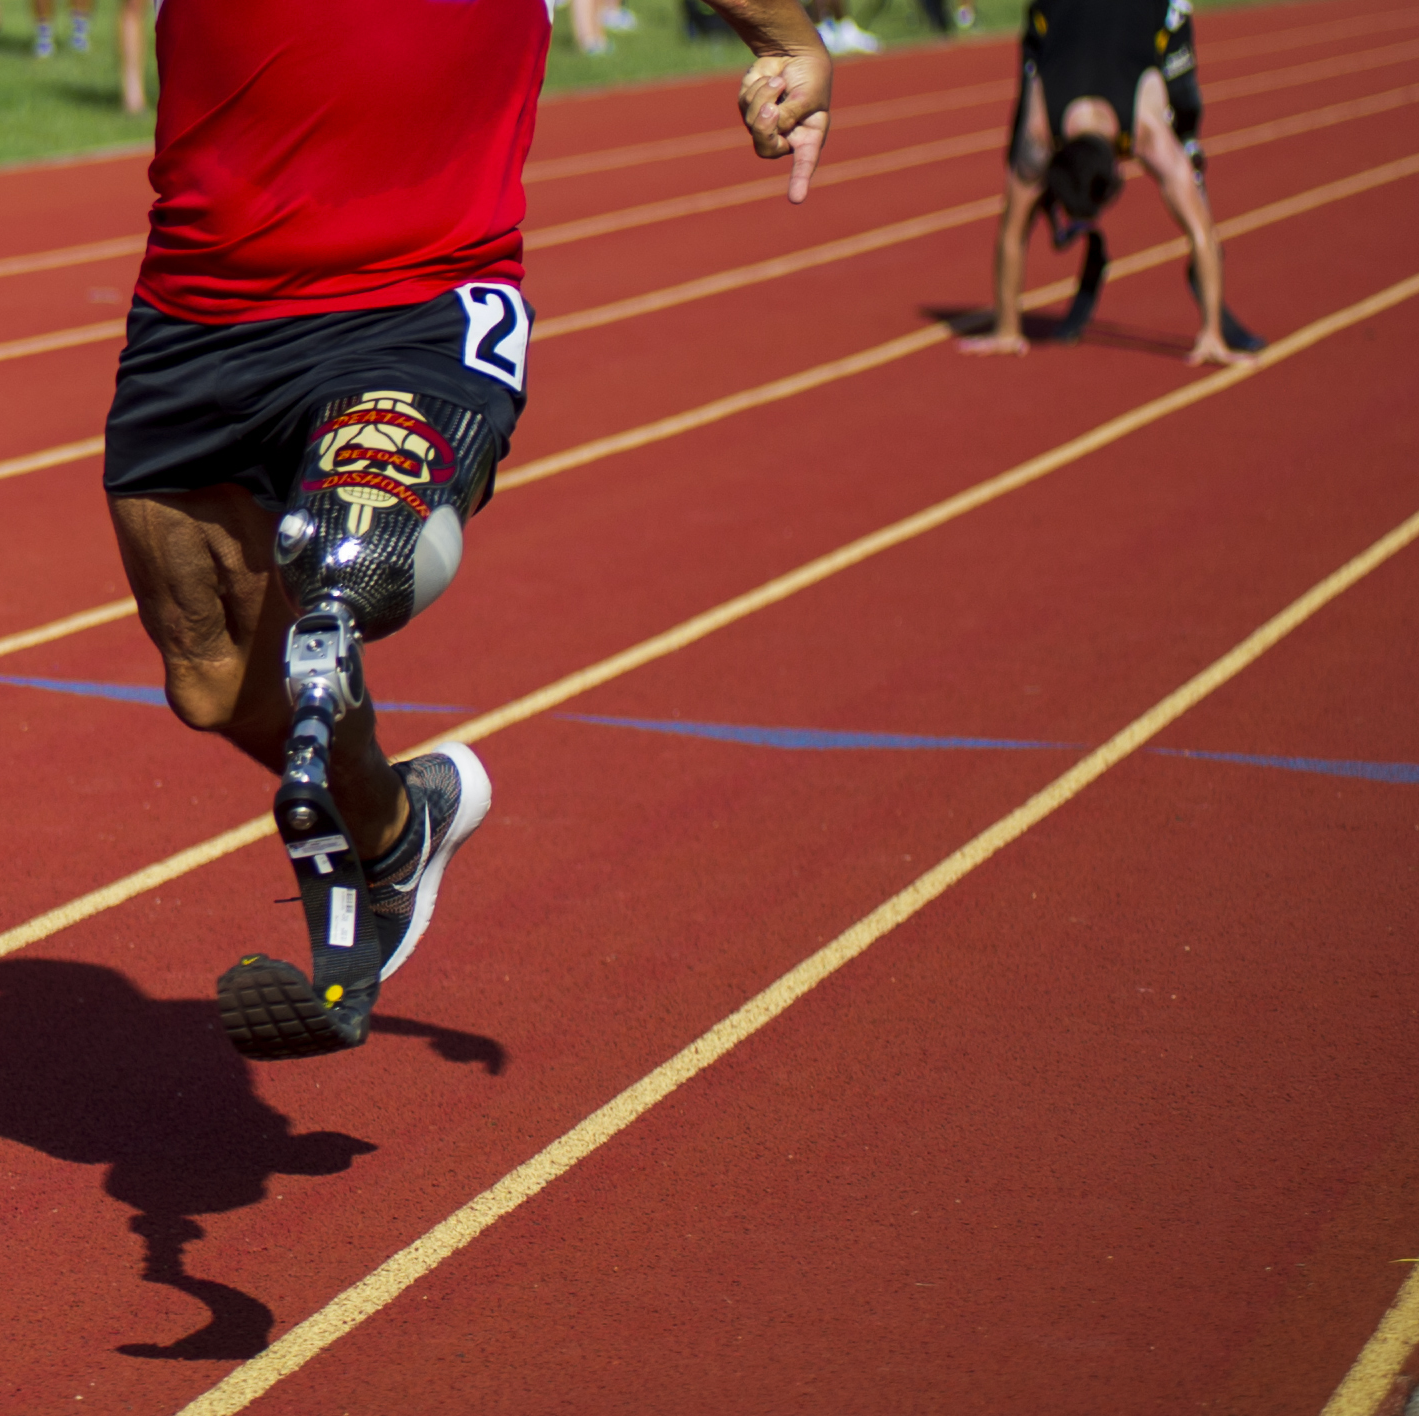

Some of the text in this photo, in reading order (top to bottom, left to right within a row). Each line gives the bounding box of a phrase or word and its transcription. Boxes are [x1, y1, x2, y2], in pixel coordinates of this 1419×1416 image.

[469, 286, 518, 378] 2
[332, 410, 416, 430] DEATH
[337, 448, 416, 470] BEFORE
[321, 471, 432, 520] DISHONOR
